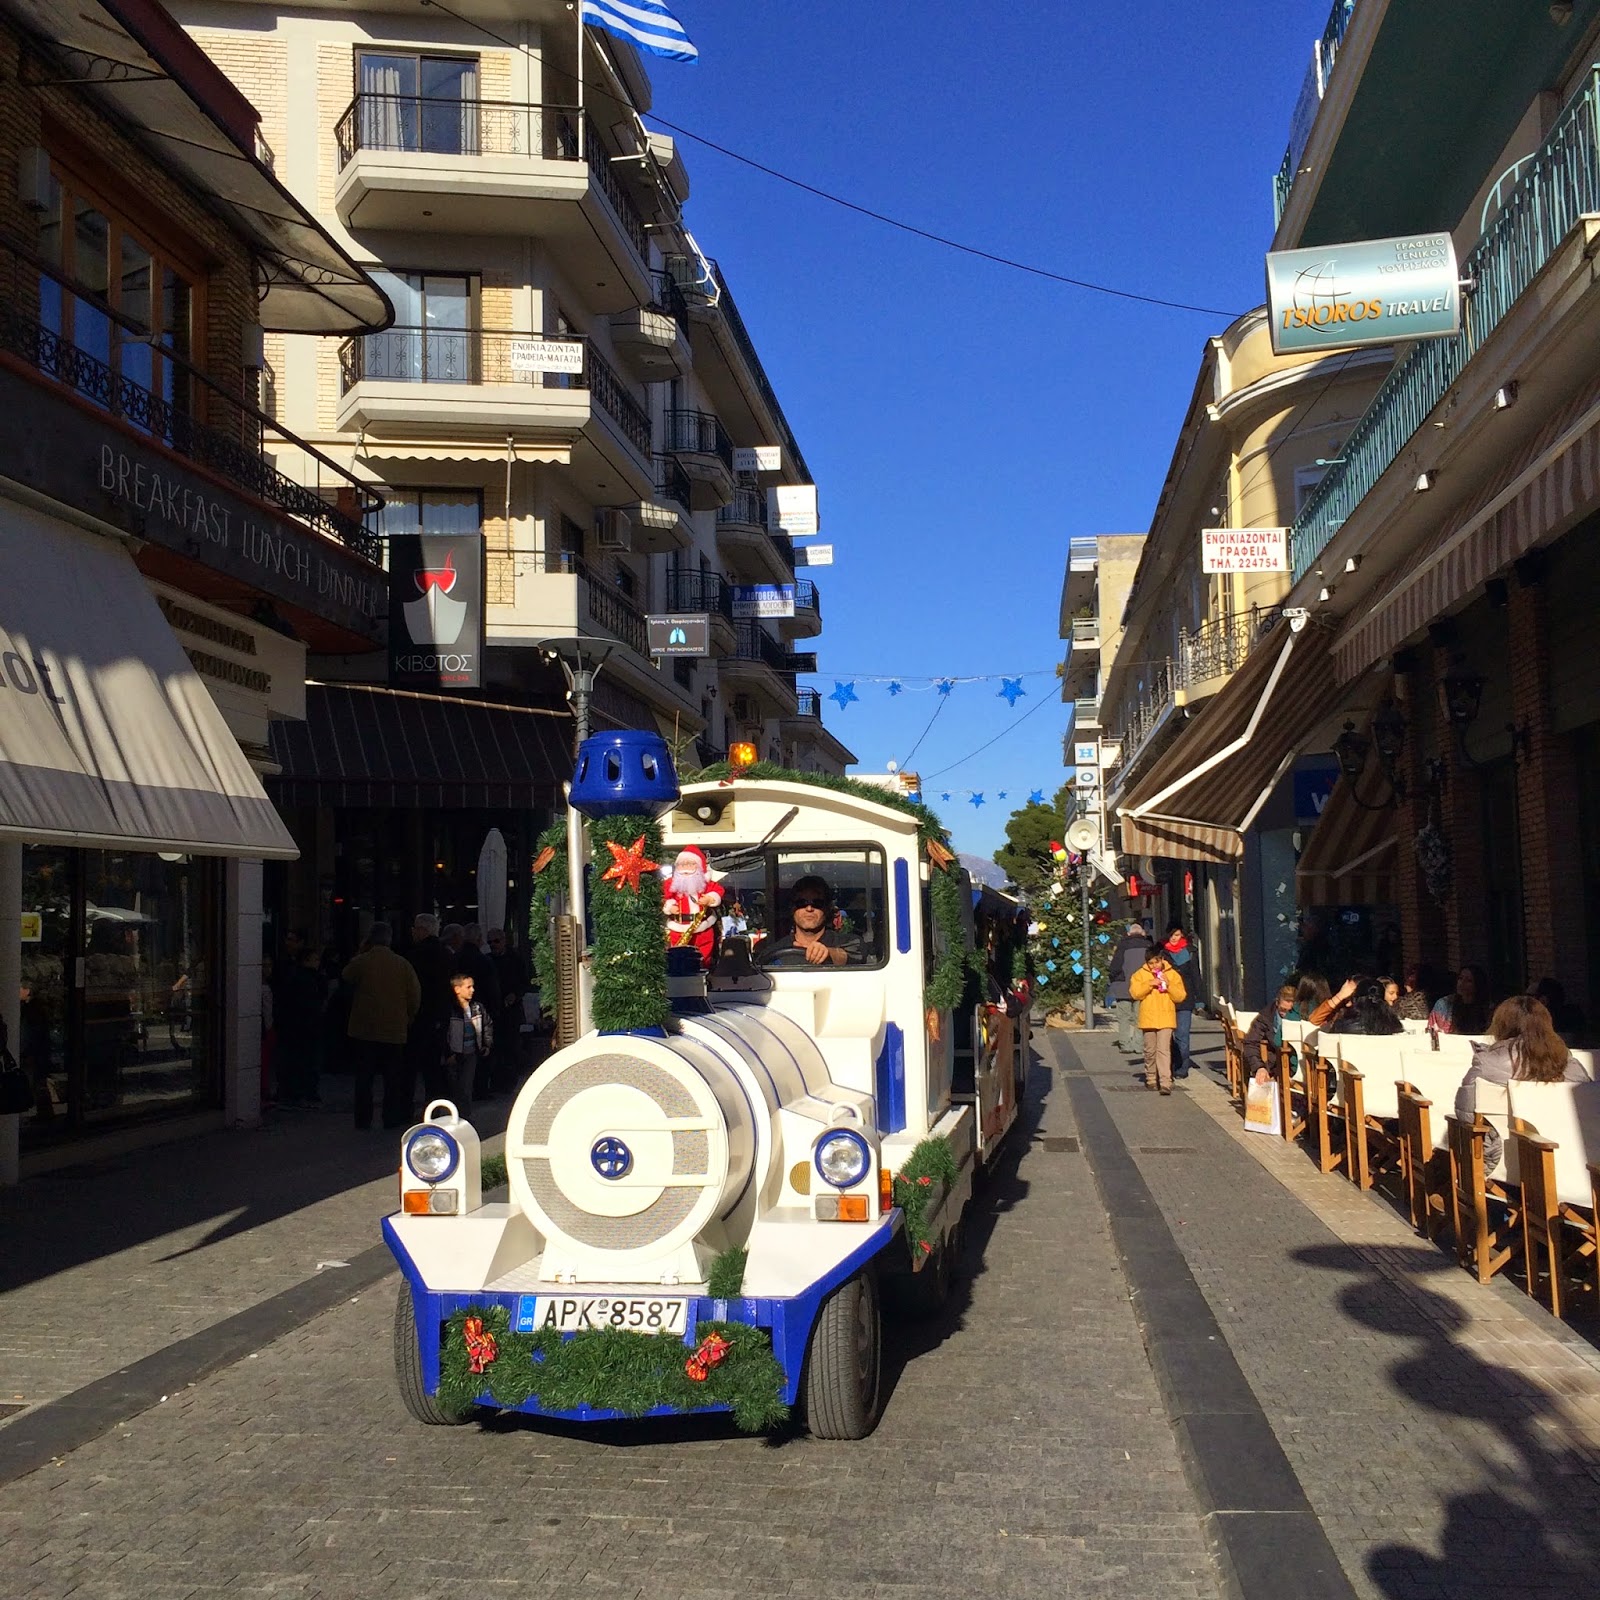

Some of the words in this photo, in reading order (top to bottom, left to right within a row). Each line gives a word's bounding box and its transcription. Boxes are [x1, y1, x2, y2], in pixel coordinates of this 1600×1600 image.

[1395, 238, 1445, 251] ΓΡΑΦΕΙΟ
[1396, 248, 1447, 262] ΓΕΝΙΚΟΥ
[1378, 257, 1449, 274] ΤΟΥΡΙΣΜΟΥ
[1282, 298, 1383, 329] TSIOROS
[512, 342, 579, 353] ΕΝΟΙΚΙΑΖΟΝΤΑΙ
[101, 444, 232, 548] BREAKFAST
[243, 520, 310, 588] LUNCH
[318, 559, 378, 618] DINNER
[1205, 533, 1282, 545] ΕΝΟΙΚΙΑΖΟΝΤΑΙ
[1219, 546, 1268, 557] ΓΡΑΦΕΙΑ
[1209, 558, 1235, 569] ΤΗΛ.
[1238, 557, 1279, 568] 224754
[520, 1318, 533, 1326] GR
